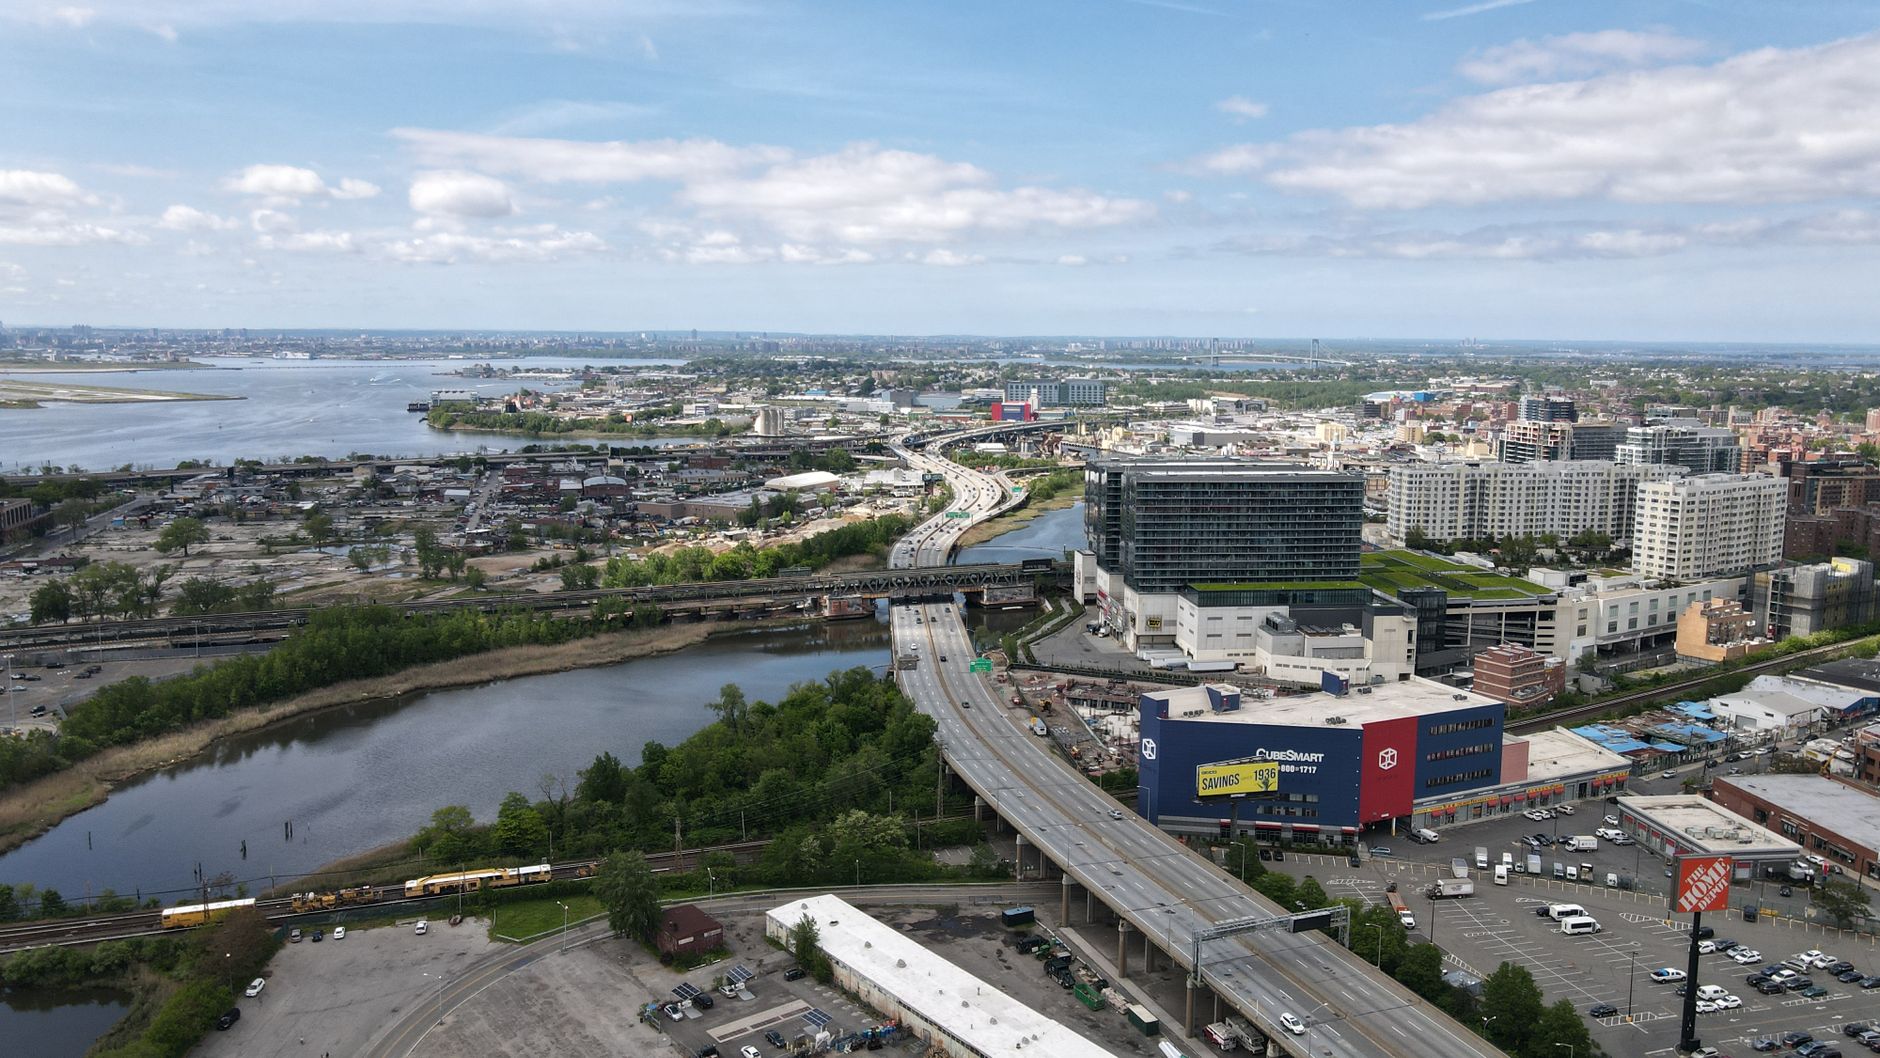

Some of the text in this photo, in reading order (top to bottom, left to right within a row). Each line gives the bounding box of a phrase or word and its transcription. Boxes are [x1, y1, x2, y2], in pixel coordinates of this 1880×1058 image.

[1202, 767, 1276, 790] SAVINGS 1936
[1679, 858, 1730, 911] HOME
[1685, 864, 1707, 885] THE
[1698, 876, 1728, 910] DEPOT
